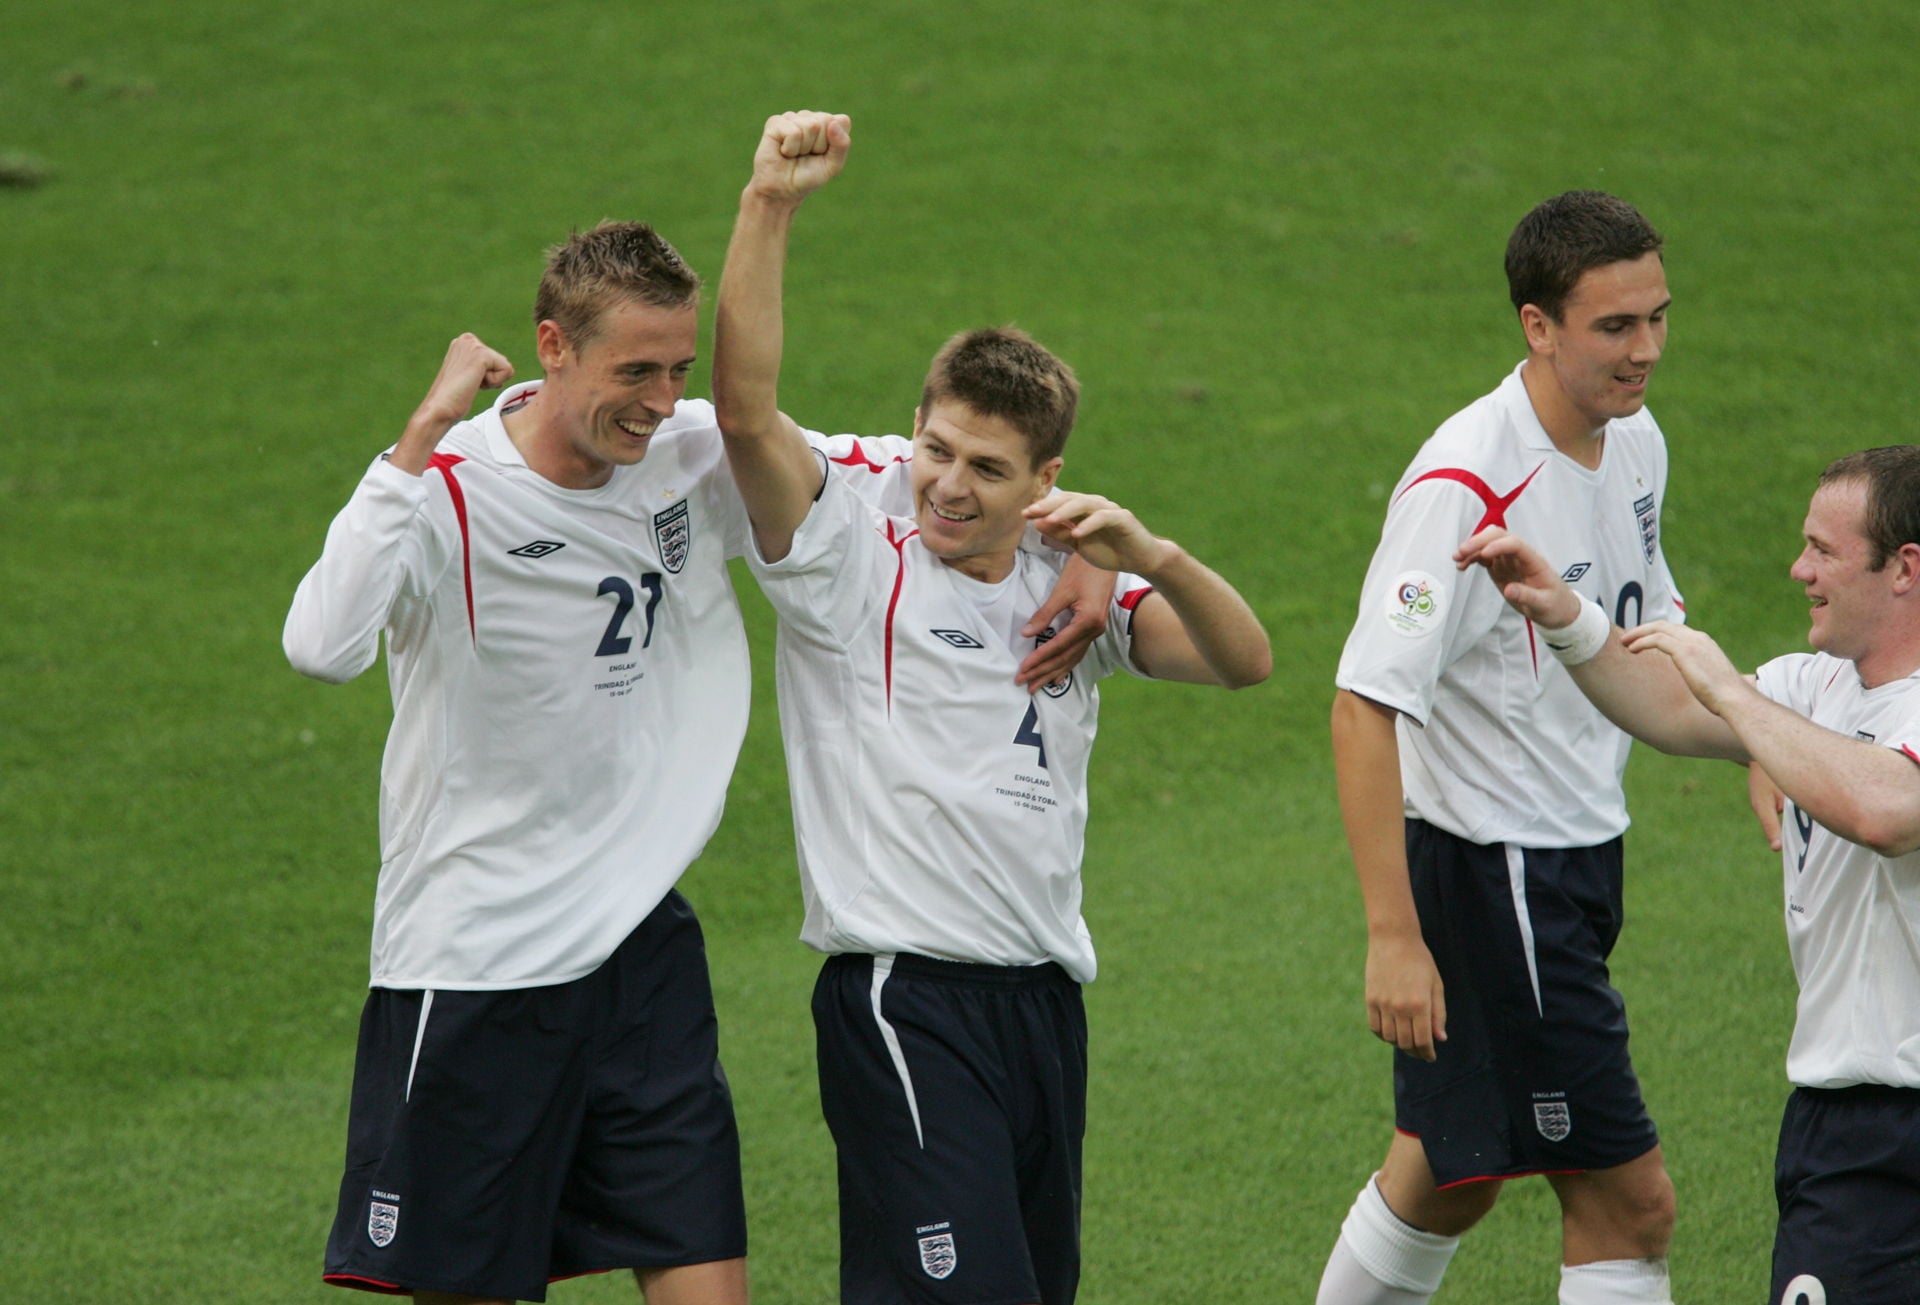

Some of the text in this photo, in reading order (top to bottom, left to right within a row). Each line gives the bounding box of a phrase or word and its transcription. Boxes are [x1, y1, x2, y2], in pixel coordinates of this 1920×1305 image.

[656, 503, 686, 523] ENGLAND
[609, 662, 637, 672] ENGLAN
[594, 680, 625, 690] TRINIDAD
[1013, 697, 1048, 769] 4
[1014, 774, 1050, 787] ENGLAND
[995, 787, 1031, 800] TRINIDAD
[1037, 796, 1058, 806] TOBA
[1532, 1091, 1566, 1099] ENGLAND
[372, 1190, 400, 1200] ENGLAND
[916, 1221, 950, 1234] ENGLAND
